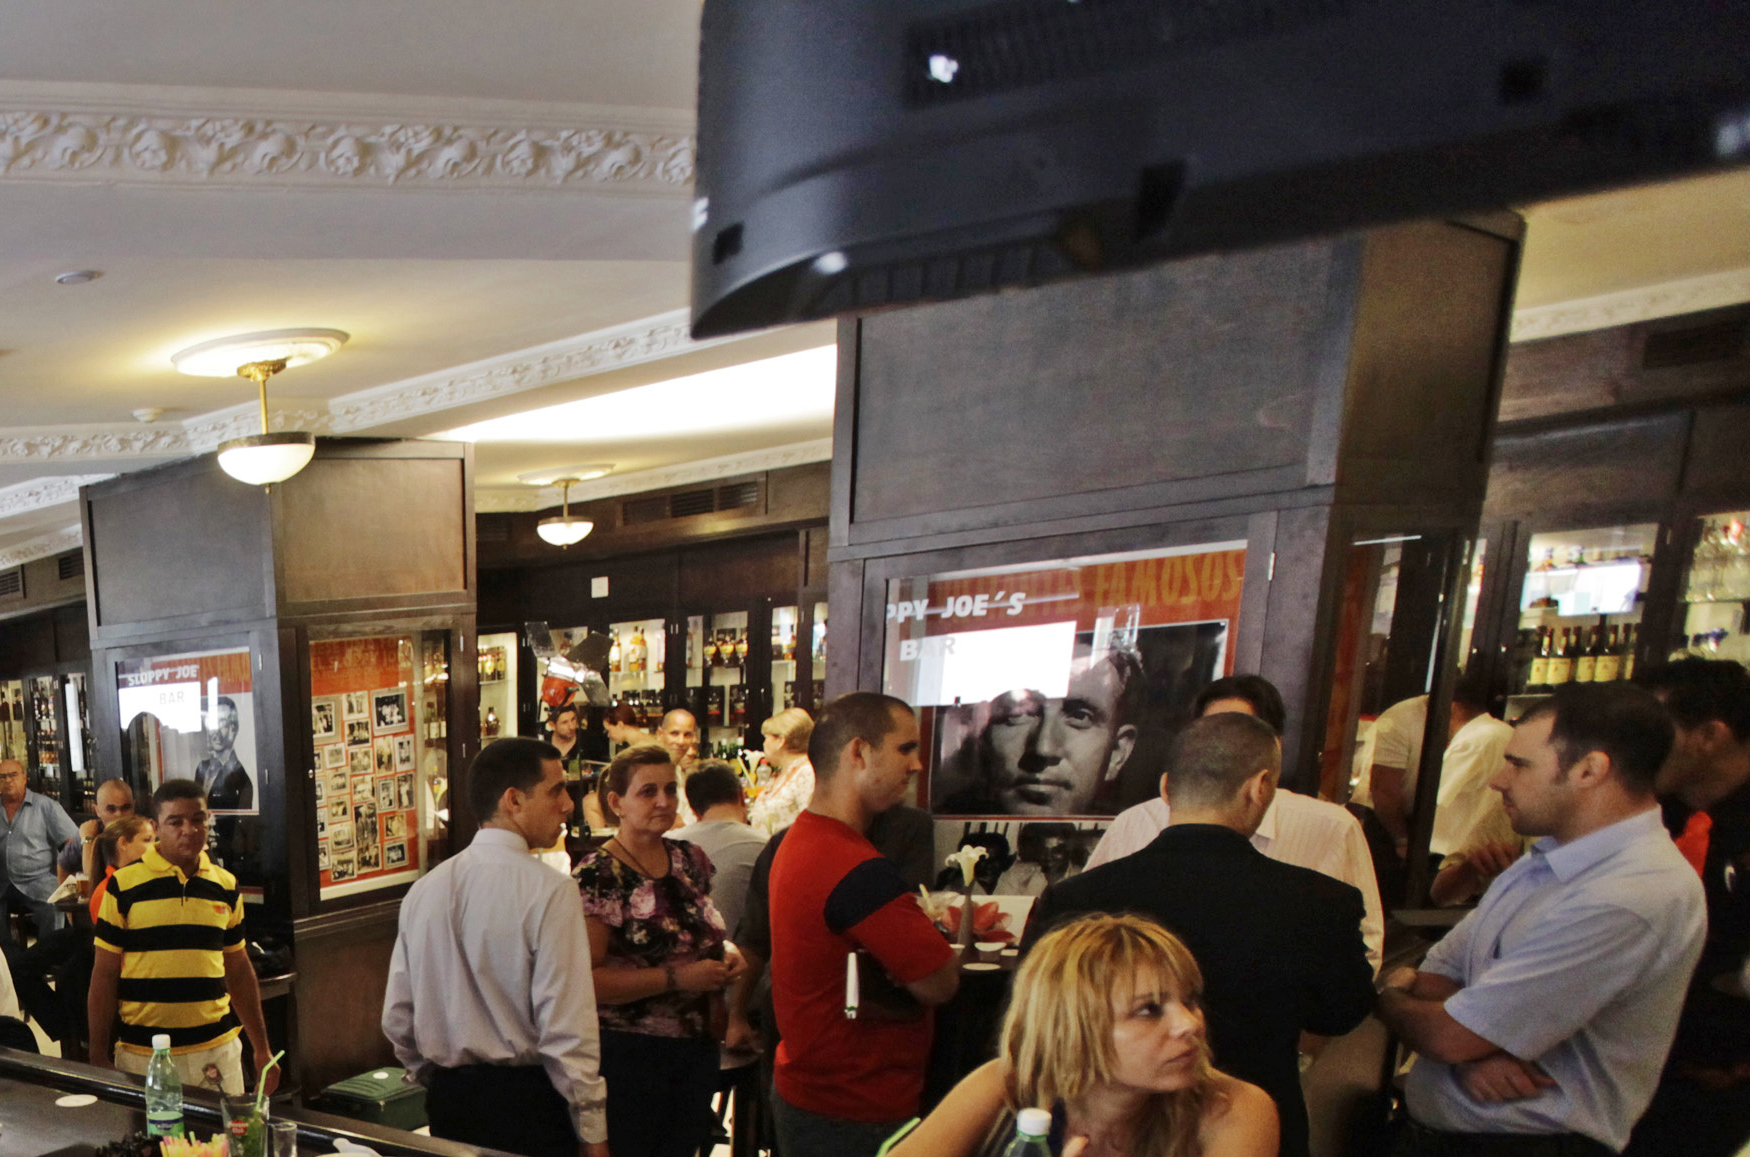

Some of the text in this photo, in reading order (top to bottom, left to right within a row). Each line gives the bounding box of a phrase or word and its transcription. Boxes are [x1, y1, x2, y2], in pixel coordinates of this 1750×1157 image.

[885, 599, 930, 625] PPY
[899, 636, 956, 662] BAR
[127, 667, 171, 687] SLOPPY
[159, 691, 185, 705] BAR
